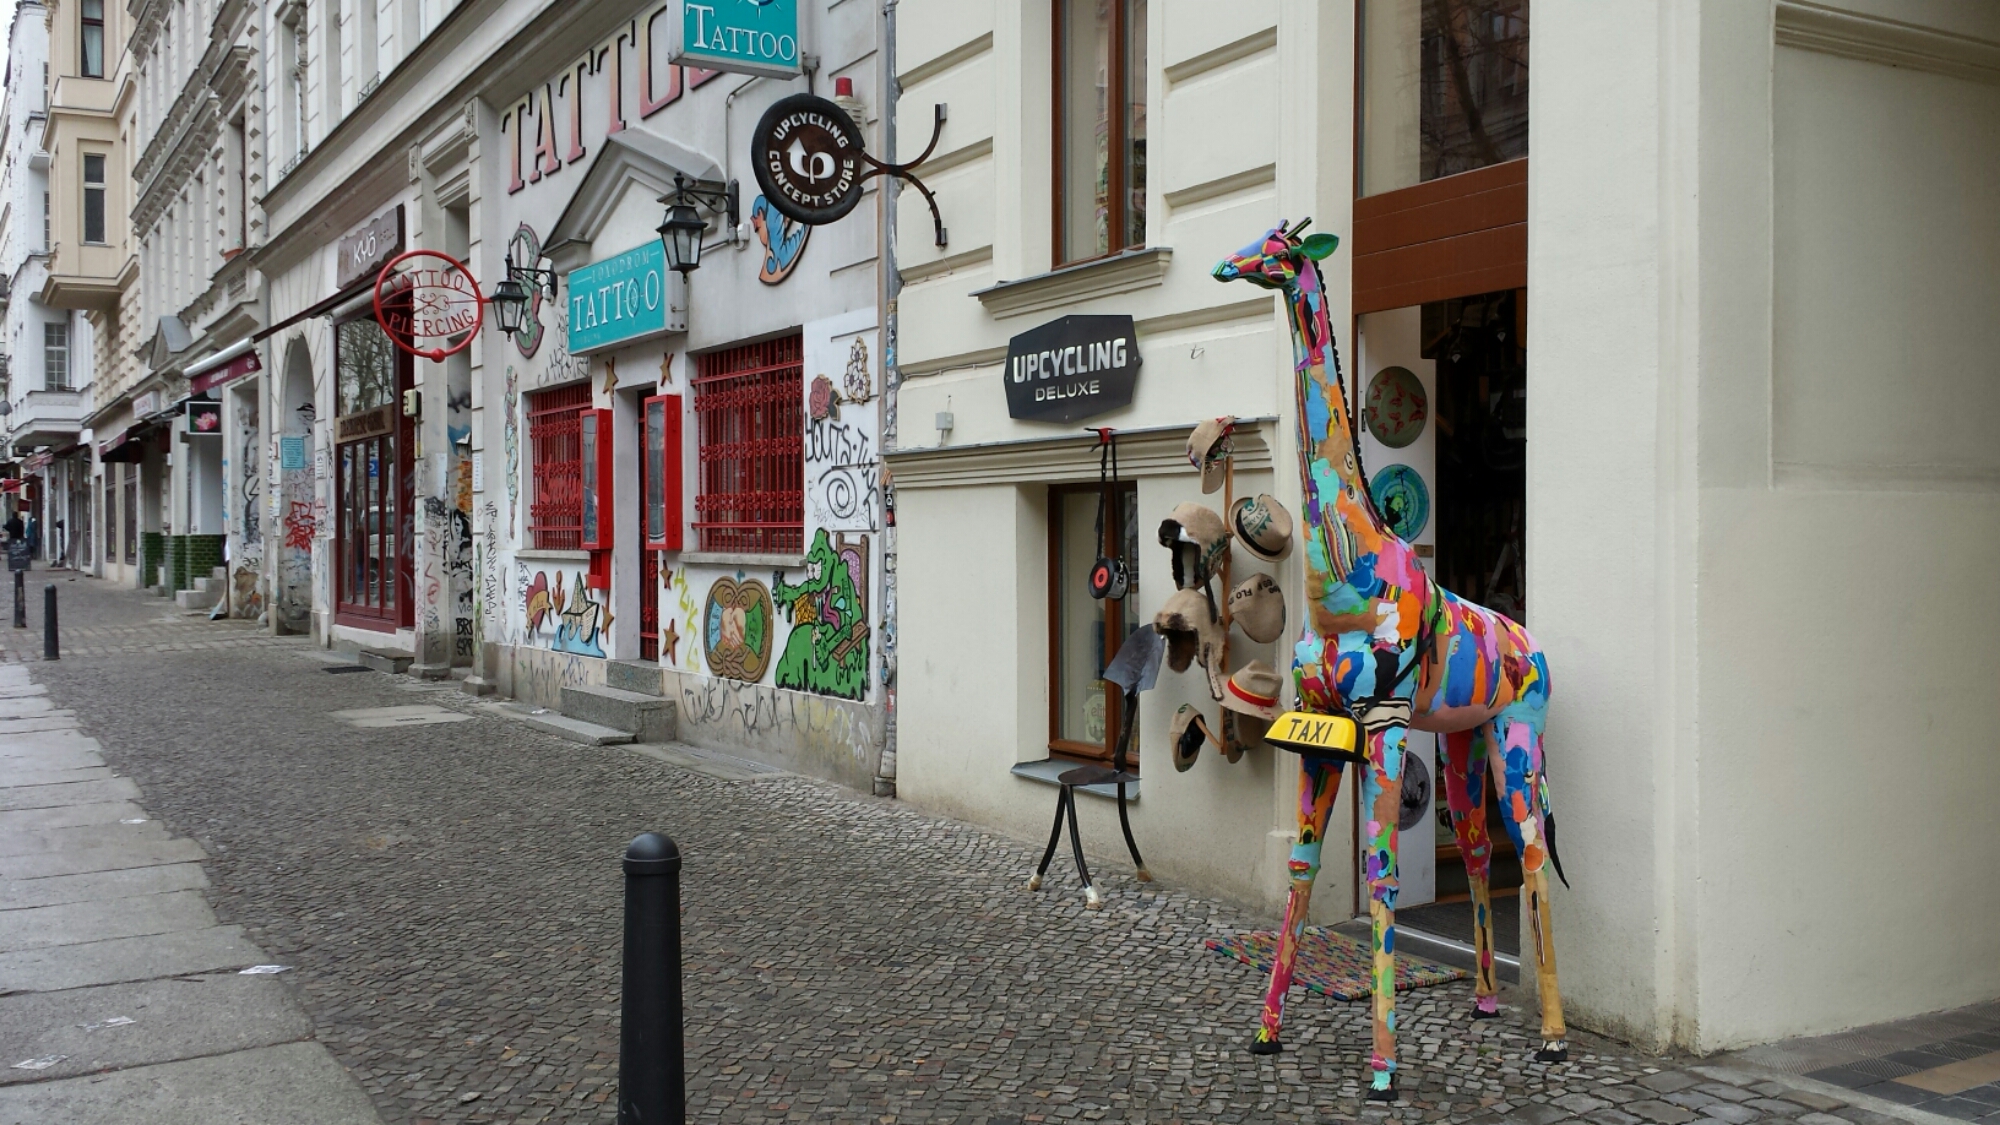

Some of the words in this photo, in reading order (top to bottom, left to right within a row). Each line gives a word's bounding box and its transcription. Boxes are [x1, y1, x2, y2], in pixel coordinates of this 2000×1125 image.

[685, 3, 796, 61] TATTOO
[501, 3, 723, 195] TATTO
[773, 112, 849, 148] UPCYCLING
[769, 150, 820, 206] CONCEPT
[823, 158, 854, 205] STORE
[387, 269, 464, 294] TATTOO
[573, 269, 660, 332] TATTOO
[388, 308, 474, 337] PIERCING
[1013, 338, 1127, 383] UPCYCLING
[1035, 380, 1100, 401] DELUXE
[1286, 718, 1334, 745] TAXI
